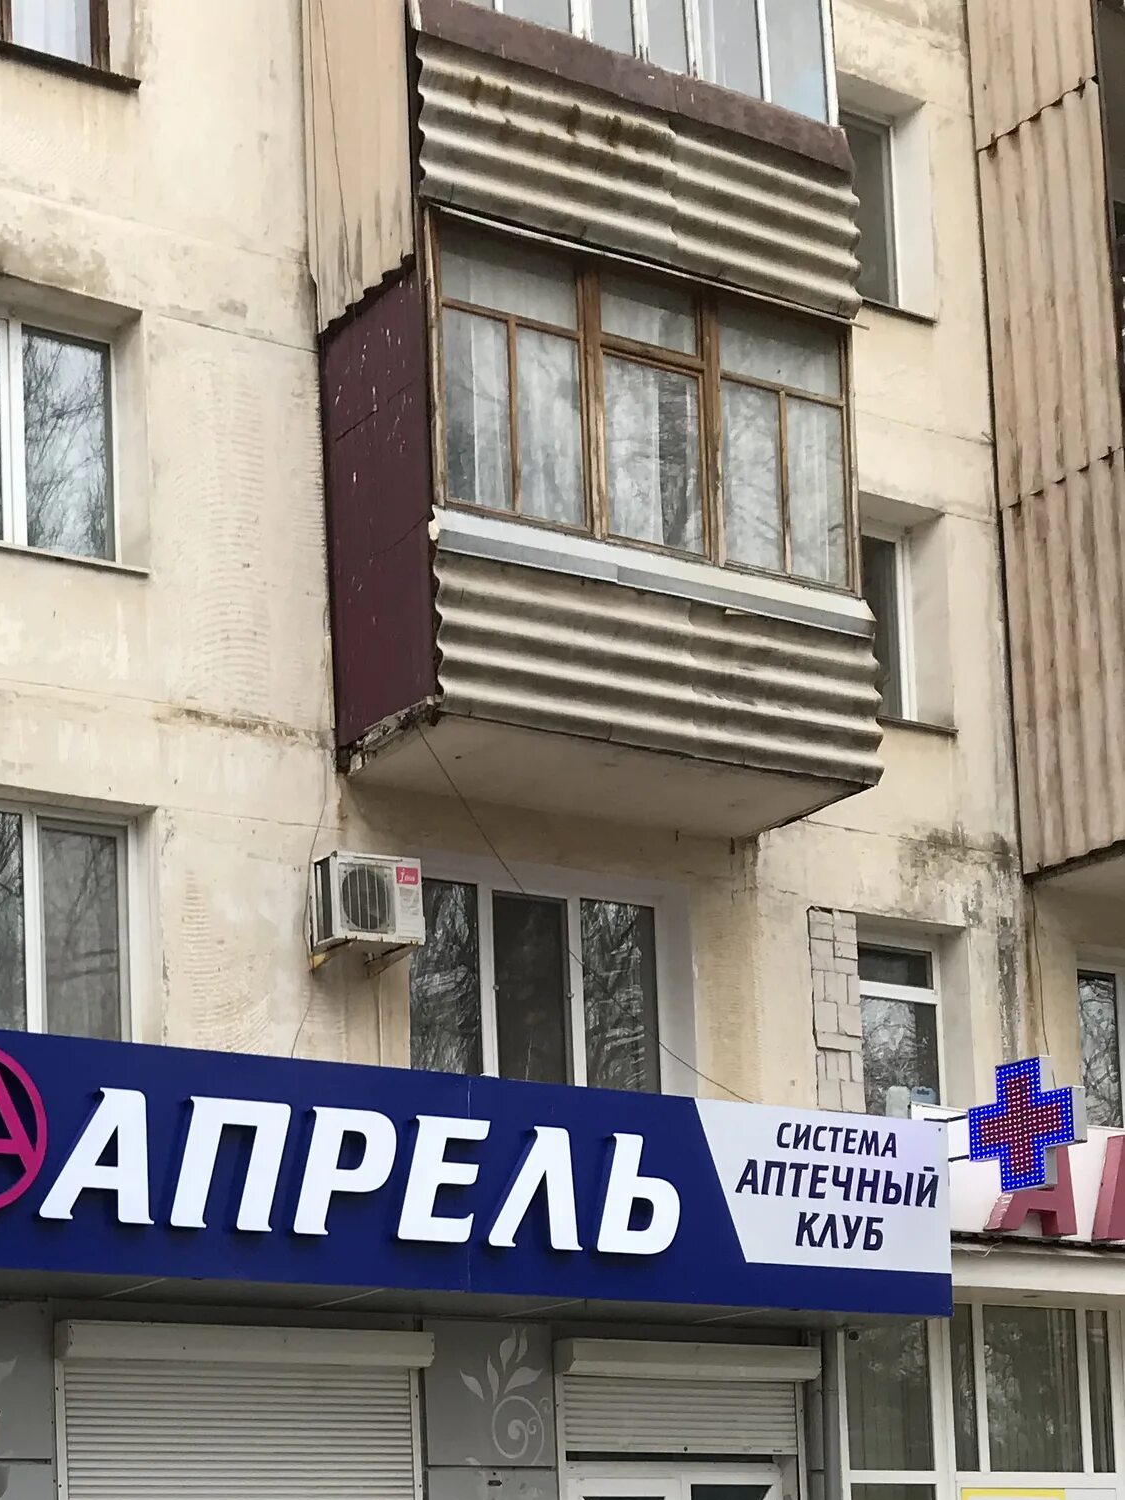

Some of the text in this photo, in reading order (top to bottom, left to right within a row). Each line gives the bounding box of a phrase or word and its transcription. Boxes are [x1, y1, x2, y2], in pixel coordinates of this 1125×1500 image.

[776, 1121, 898, 1158] СИСТЕМА
[39, 1086, 681, 1256] АПРЕЛЬ
[734, 1158, 940, 1208] АПТЕЧНЫЙ
[794, 1211, 885, 1251] КЛУБ
